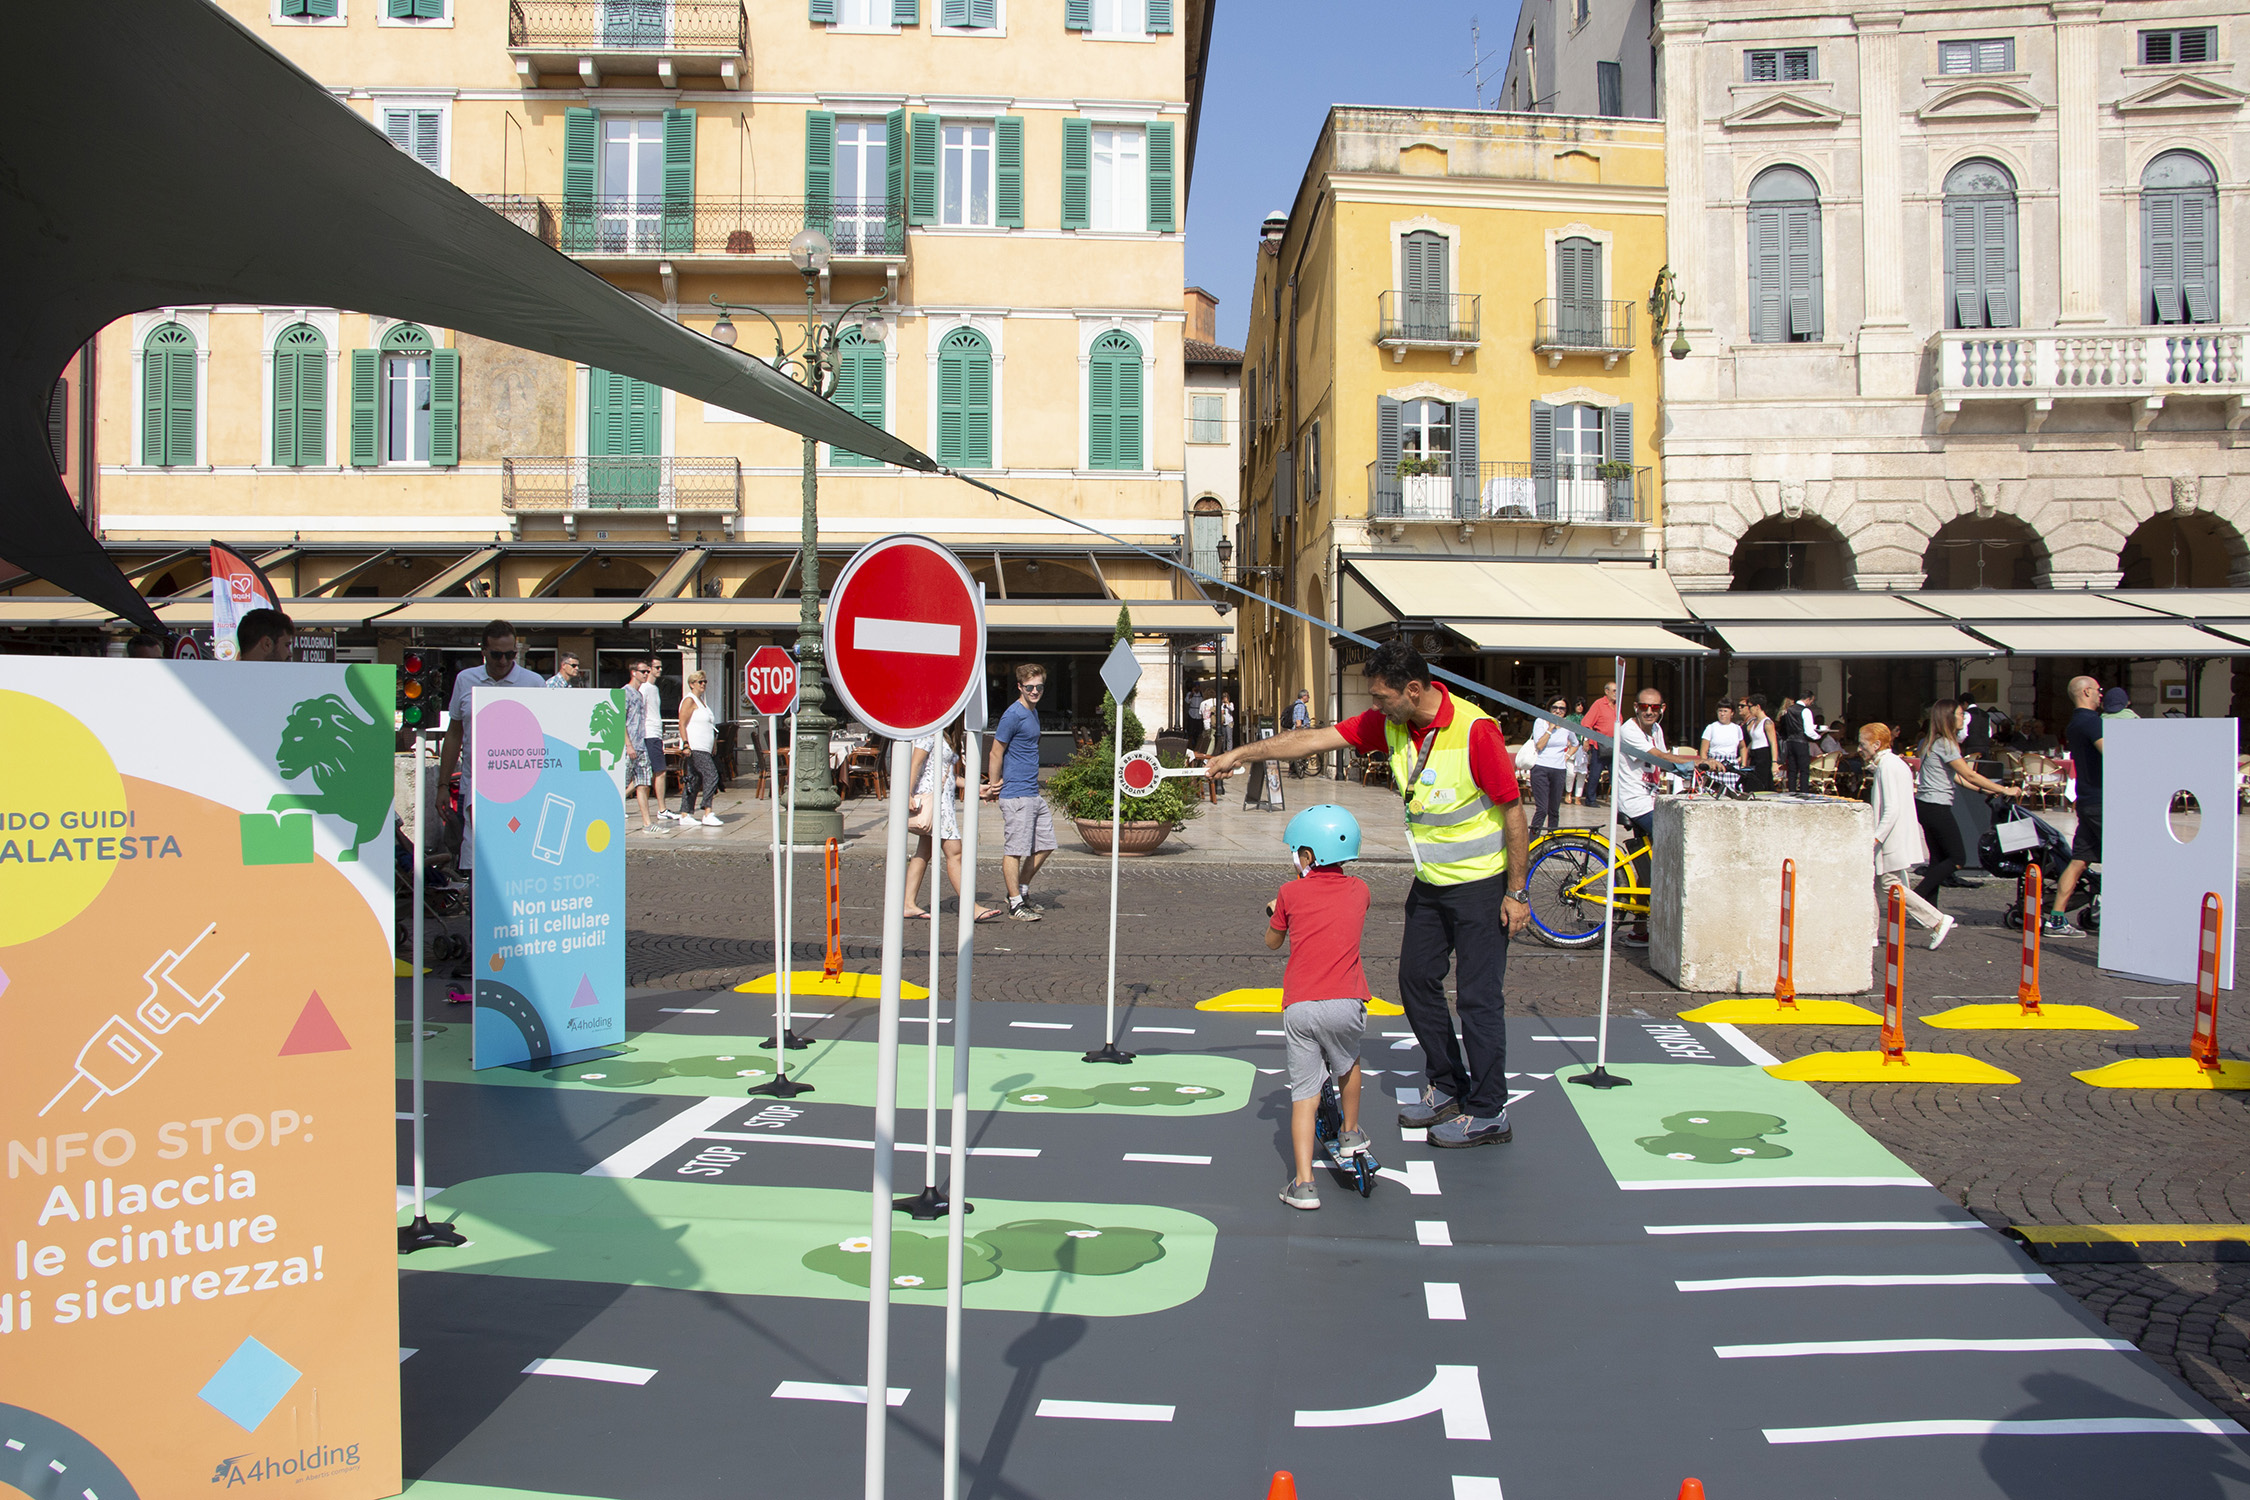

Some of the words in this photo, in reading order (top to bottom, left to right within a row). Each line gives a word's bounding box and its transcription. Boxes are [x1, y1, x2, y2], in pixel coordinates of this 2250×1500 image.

[293, 636, 299, 648] A
[300, 636, 334, 649] COLOGNOLA
[302, 650, 309, 661] AI
[309, 650, 326, 662] COLLI
[749, 666, 794, 695] STOP
[487, 748, 525, 757] QUANDO
[526, 748, 549, 756] GUIDI
[487, 758, 563, 770] #USALATESTA
[1118, 766, 1145, 794] AUTOSTRADA
[0, 812, 50, 831] DO
[59, 810, 136, 829] GUIDI
[505, 877, 547, 897] INFO
[553, 873, 600, 892] STOP:
[512, 899, 546, 916] Non
[551, 896, 593, 912] usare
[493, 920, 524, 939] mai
[529, 918, 538, 935] il
[543, 912, 610, 933] cellulare
[498, 939, 557, 959] mentre
[561, 930, 606, 954] guidi!
[571, 1016, 613, 1031] A4holding
[1641, 1024, 1716, 1059] FINISH
[743, 1104, 804, 1129] STOP
[157, 1109, 314, 1160] STOP:
[677, 1145, 747, 1177] STOP
[37, 1163, 256, 1227] Allaccia
[16, 1239, 67, 1281] le
[87, 1214, 278, 1268] cinture
[54, 1245, 324, 1324] sicurezza!
[226, 1443, 361, 1489] A4holding
[305, 1471, 330, 1481] Abertis
[330, 1464, 361, 1476] company
